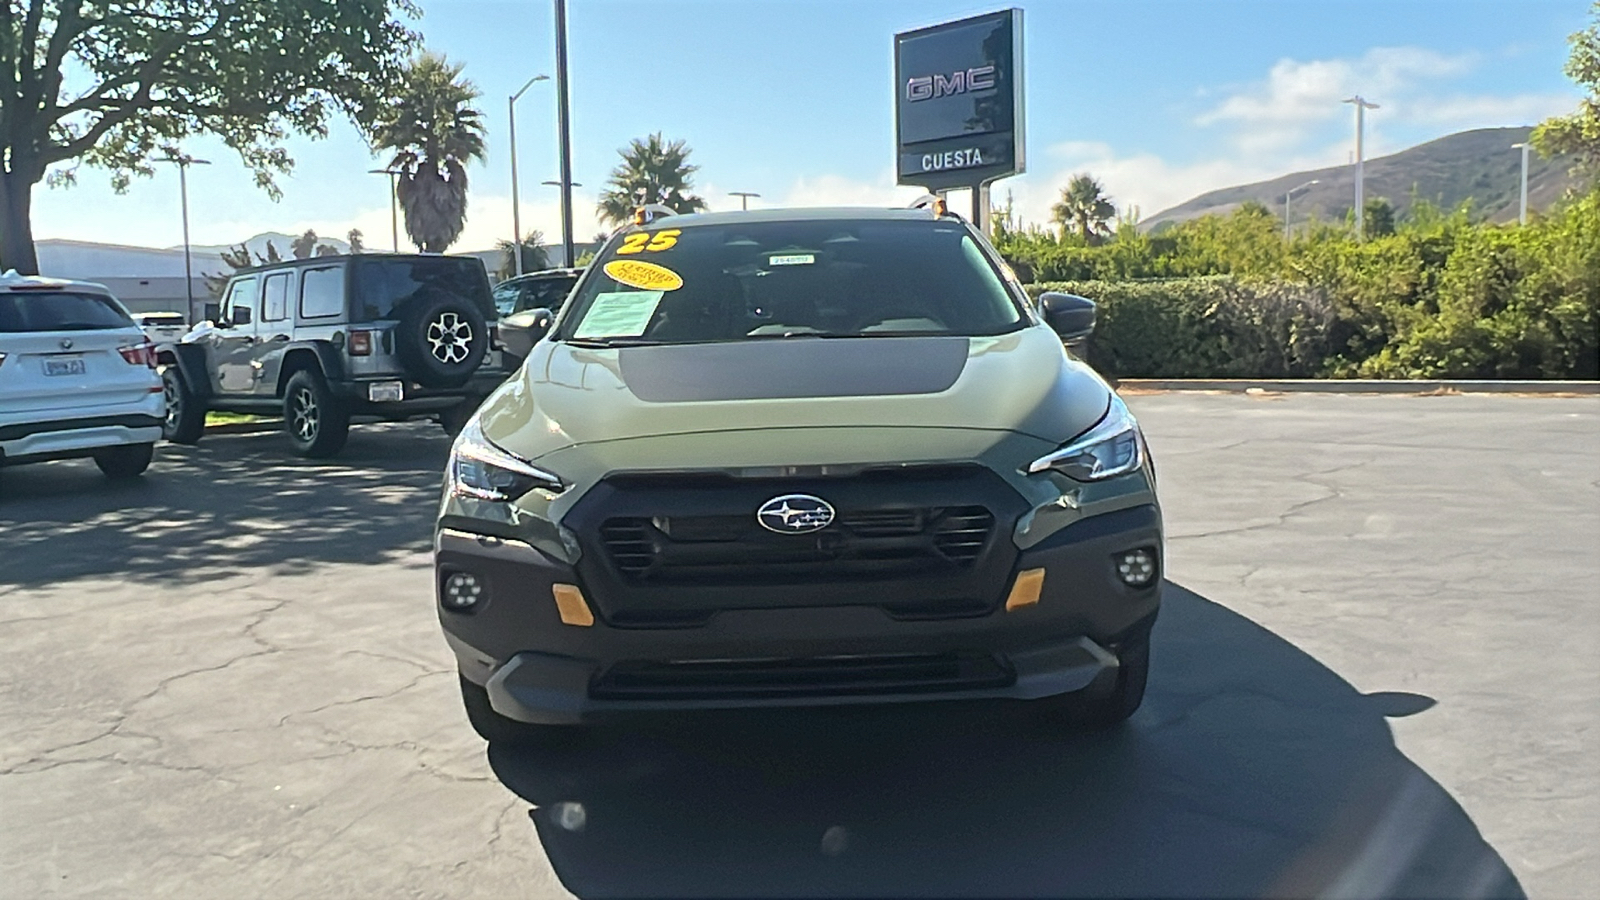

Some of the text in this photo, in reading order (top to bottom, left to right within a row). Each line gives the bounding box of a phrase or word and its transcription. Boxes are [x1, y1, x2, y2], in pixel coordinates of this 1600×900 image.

[906, 66, 994, 102] GMC
[922, 149, 983, 171] CUESTA
[616, 229, 682, 255] 25
